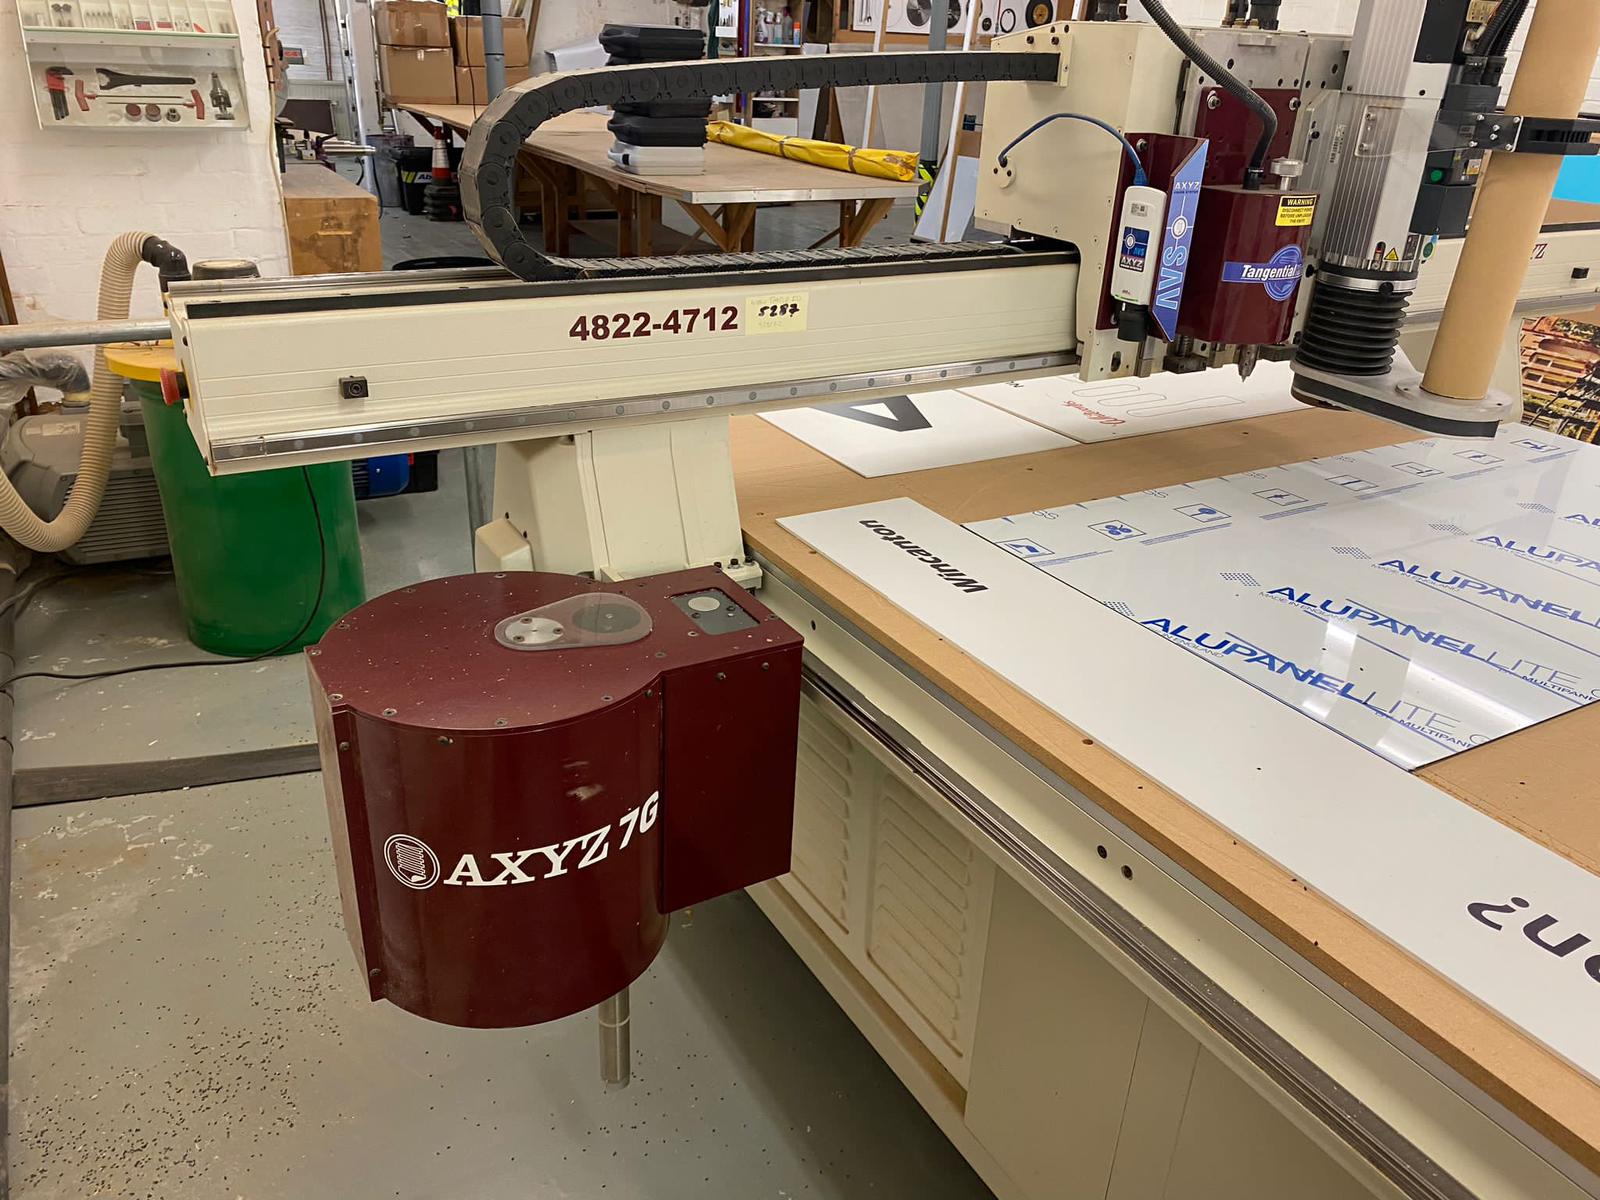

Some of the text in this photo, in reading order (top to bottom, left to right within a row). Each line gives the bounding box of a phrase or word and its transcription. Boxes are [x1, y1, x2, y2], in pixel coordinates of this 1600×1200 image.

[1174, 181, 1200, 190] AXYZ
[1287, 198, 1314, 206] WARNING
[1121, 256, 1144, 268] AXYZ
[1241, 263, 1298, 281] Tangential
[569, 306, 738, 341] 4822-4712
[858, 519, 989, 594] Wincanton
[443, 790, 659, 887] AXYZ 7G
